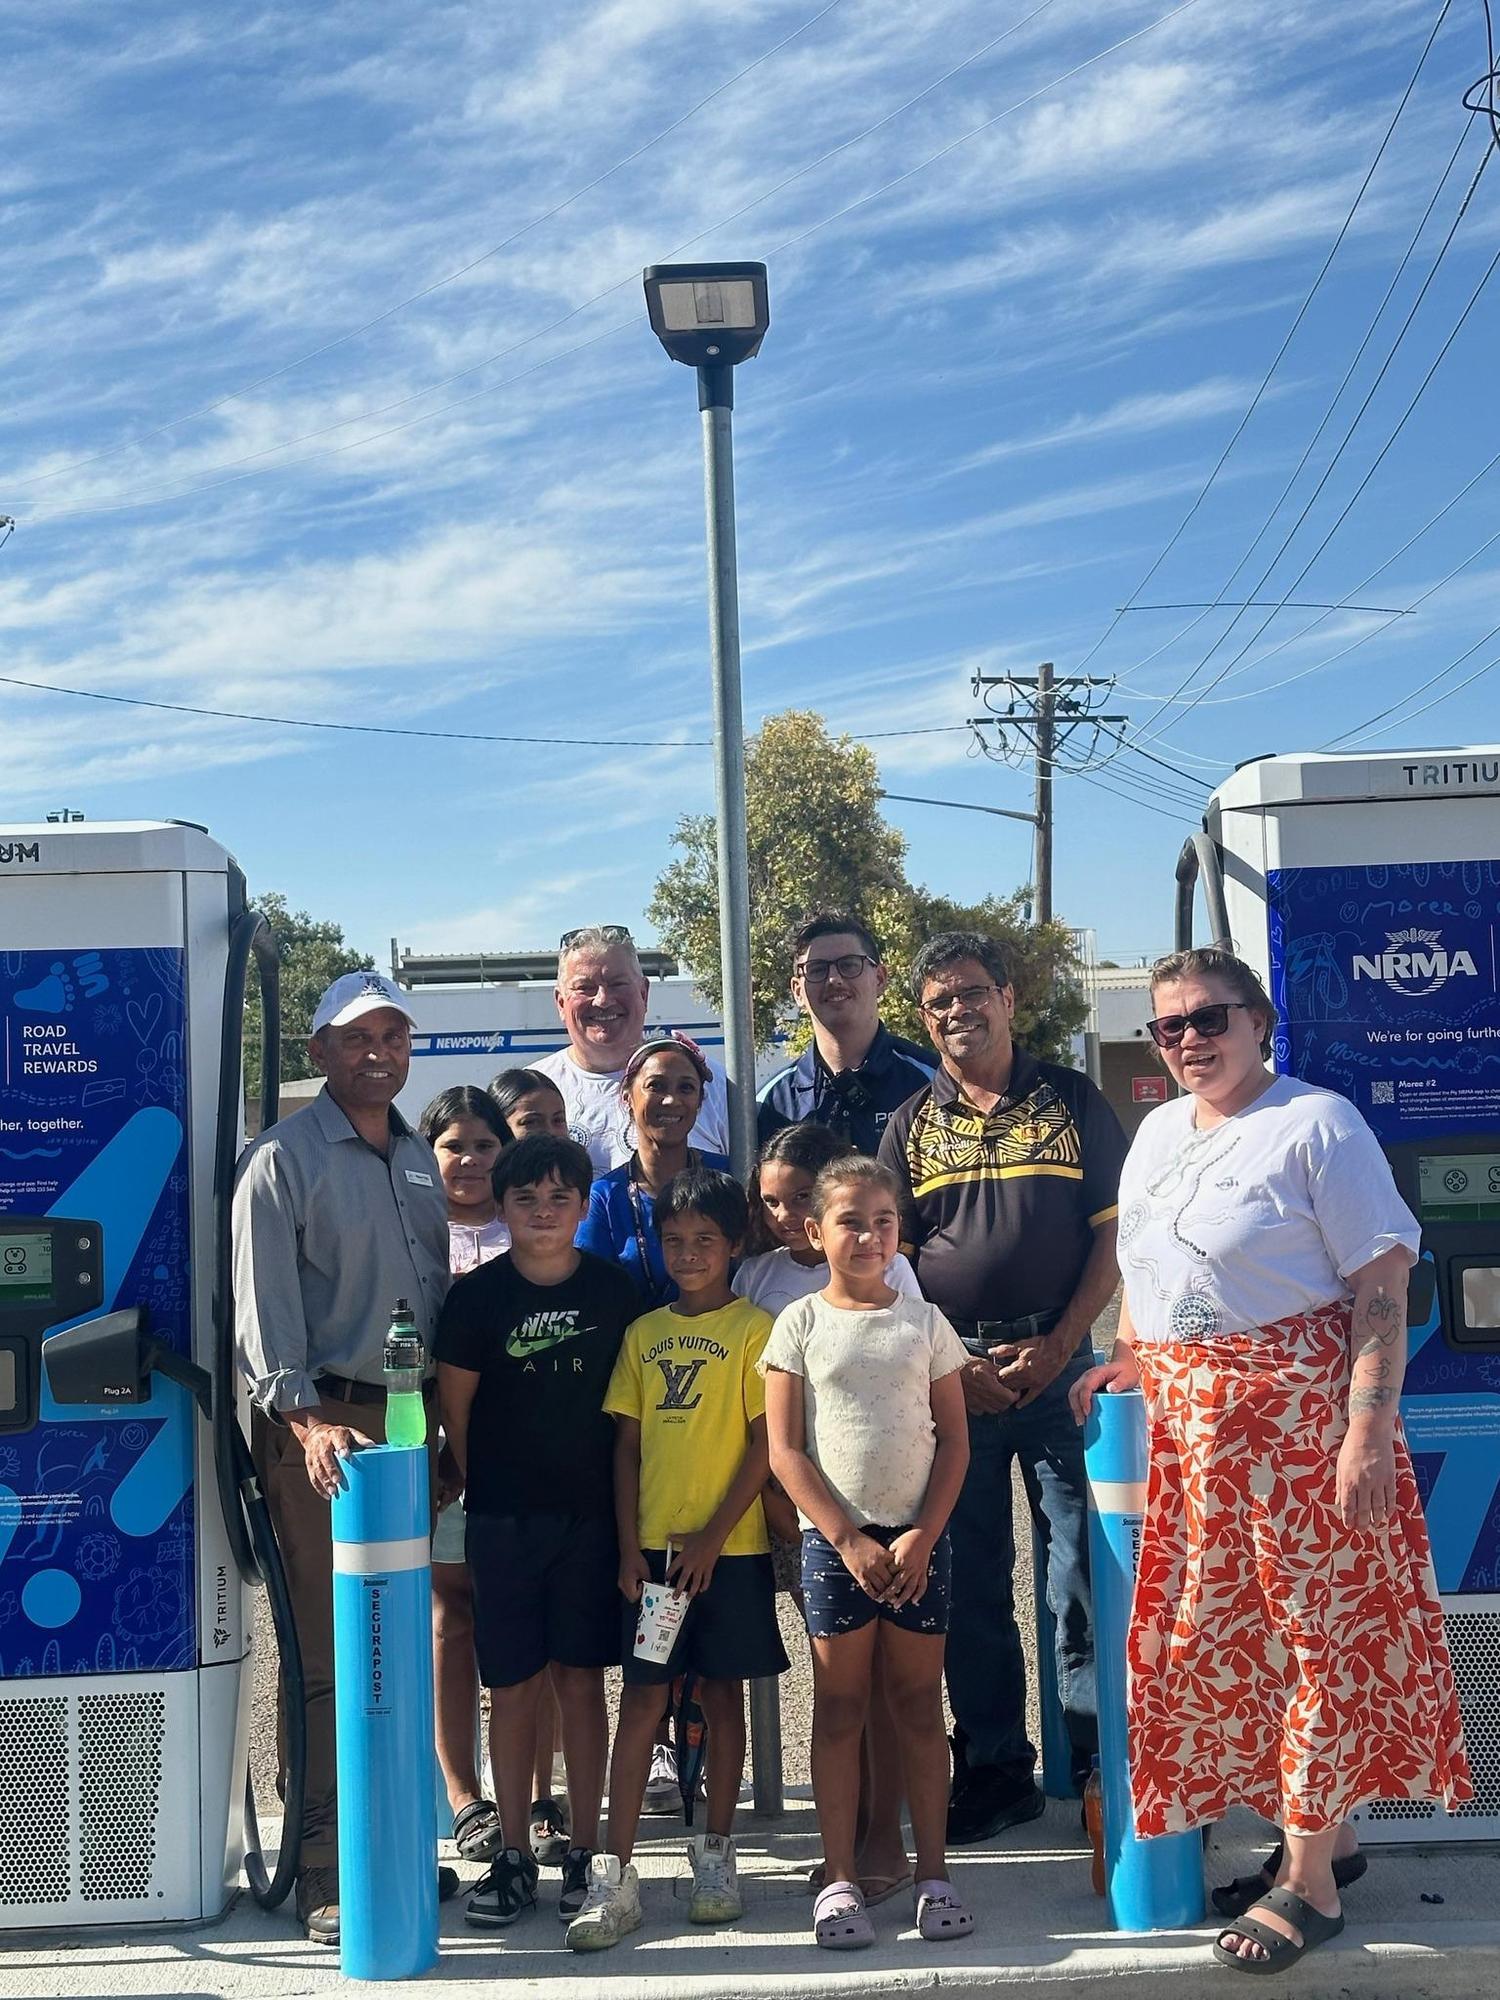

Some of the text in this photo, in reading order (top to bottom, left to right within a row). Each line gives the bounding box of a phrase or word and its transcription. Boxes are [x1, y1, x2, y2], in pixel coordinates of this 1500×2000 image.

[1353, 950, 1478, 980] NRMA
[23, 1025, 66, 1038] ROAD
[1366, 1031, 1402, 1043] We're
[1405, 1029, 1423, 1042] for
[1427, 1028, 1463, 1044] going
[23, 1042, 80, 1056] TRAVEL
[23, 1060, 98, 1074] REWARDS
[1399, 1080, 1424, 1089] Moree
[27, 1117, 84, 1133] together.
[520, 1310, 581, 1338] NIKE
[641, 1335, 729, 1364] LOUIS VUITTON
[104, 1387, 132, 1396] Plug 2A
[217, 1565, 227, 1625] TRITIUM
[371, 1588, 383, 1704] SECURAPOST
